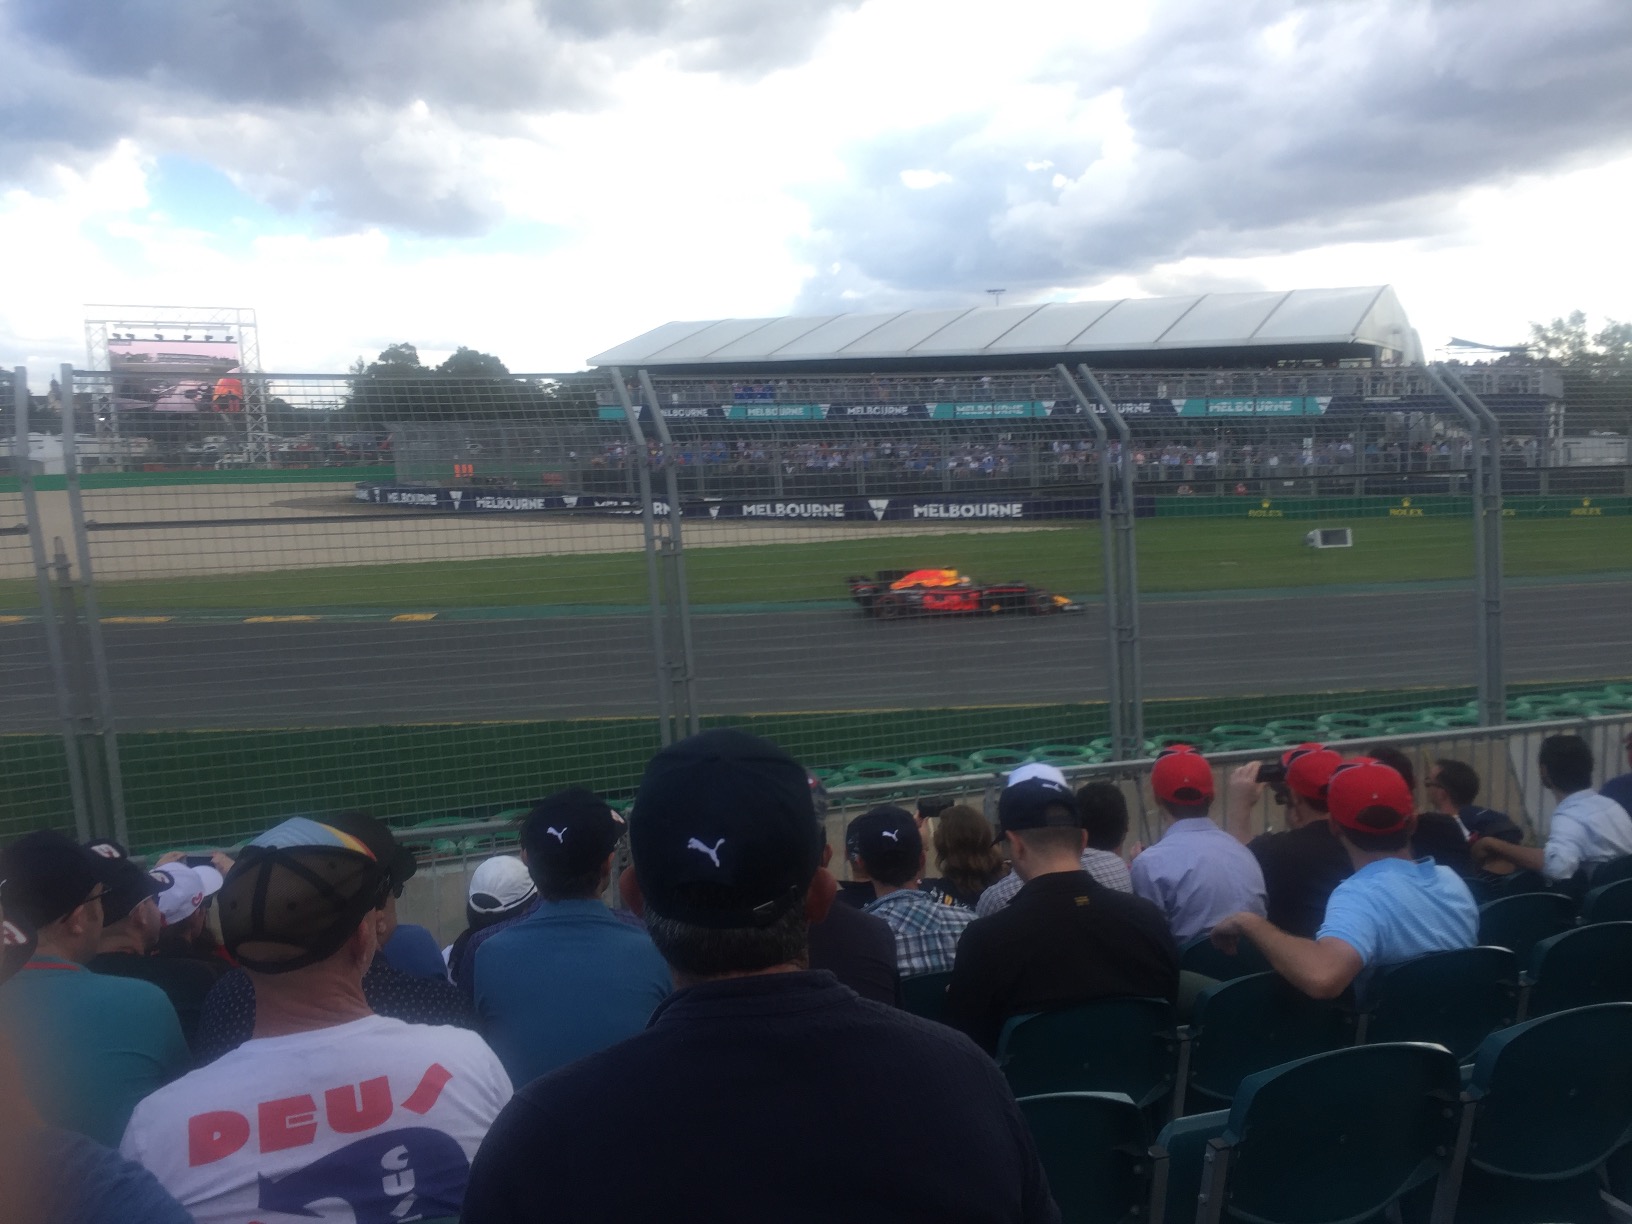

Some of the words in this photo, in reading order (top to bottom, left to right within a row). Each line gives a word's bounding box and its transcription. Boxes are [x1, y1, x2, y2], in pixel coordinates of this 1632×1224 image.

[747, 407, 804, 416] MELBOURNE
[847, 405, 909, 416] MELBOURNE
[956, 404, 1024, 415] MELBOURNE
[1209, 401, 1293, 413] MELBOURNE
[387, 492, 438, 506] MELBOURNE
[476, 496, 546, 510] MELBOURNE
[742, 503, 845, 517] MELBOURNE
[913, 503, 1023, 518] MELBOURNE
[1390, 508, 1424, 517] ROLEX
[188, 1062, 454, 1168] DEUS
